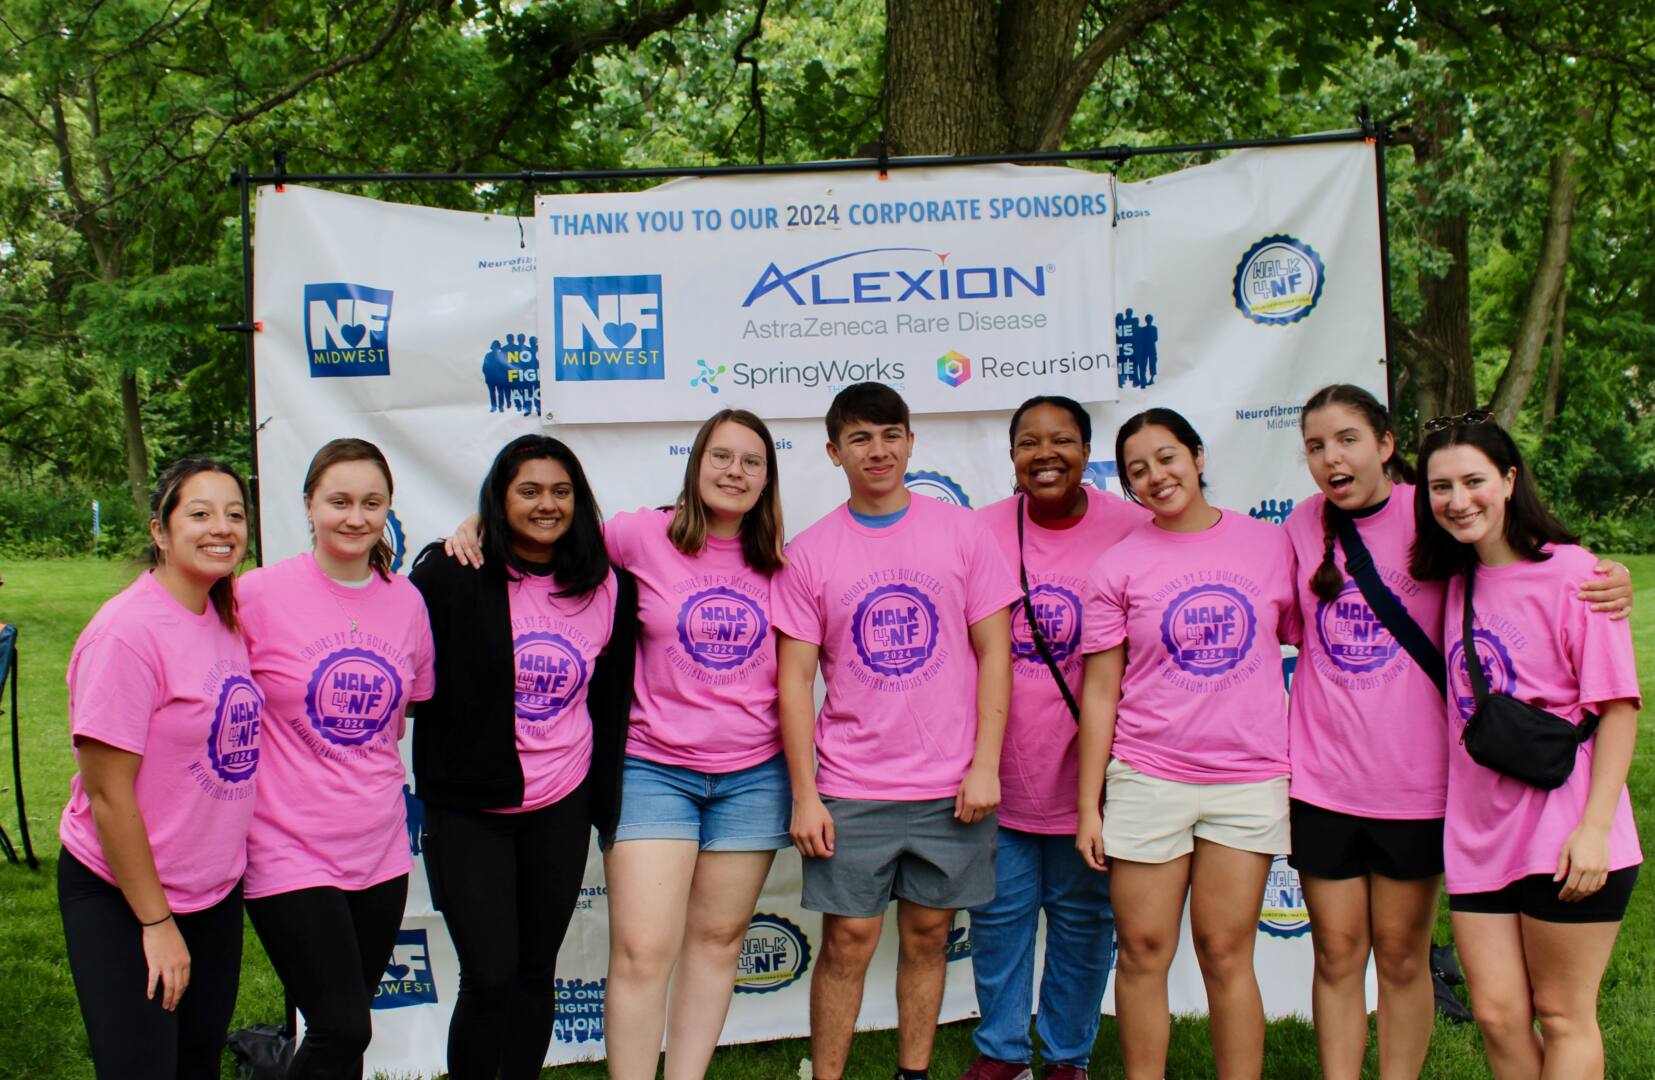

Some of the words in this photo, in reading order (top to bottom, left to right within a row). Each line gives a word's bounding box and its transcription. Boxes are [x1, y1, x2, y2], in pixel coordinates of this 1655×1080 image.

[550, 211, 629, 236] THANK
[636, 209, 684, 233] YOU
[691, 208, 722, 231] TO
[730, 207, 779, 230] OUR
[786, 203, 840, 227] 2024
[848, 198, 982, 226] CORPORATE
[988, 193, 1107, 220] SPONSORS
[741, 250, 1046, 307] ALEXION
[1253, 257, 1300, 279] WALK
[1253, 273, 1302, 299] 4NF
[309, 299, 388, 350] NF
[561, 293, 658, 350] NF
[742, 316, 888, 340] AstraZeneca
[896, 313, 949, 334] Rare
[958, 311, 1047, 332] Disease
[314, 349, 385, 366] MIDWEST
[507, 350, 532, 363] NO
[563, 350, 660, 366] MIDWEST
[982, 351, 1110, 379] Recursion
[733, 357, 905, 389] SpringWorks
[1236, 405, 1304, 420] Neurofibrom
[700, 606, 748, 622] WALK
[871, 606, 919, 627] WALK
[1183, 605, 1236, 625] WALK
[1336, 602, 1375, 622] WAL
[702, 621, 748, 642] 4NF
[873, 623, 920, 647] 4NF
[1186, 622, 1236, 646] 4NF
[706, 643, 734, 653] 2024
[883, 649, 912, 660] 2024
[1194, 649, 1224, 659] 2024
[1343, 646, 1373, 656] 2024
[519, 653, 571, 674] WALK
[333, 672, 387, 693] WALK
[517, 671, 568, 693] 4NF
[332, 692, 382, 714] 4NF
[522, 694, 551, 705] 2024
[230, 700, 260, 724] WALK
[336, 719, 365, 728] 2024
[229, 750, 252, 763] 2024
[554, 1018, 604, 1031] ALON
